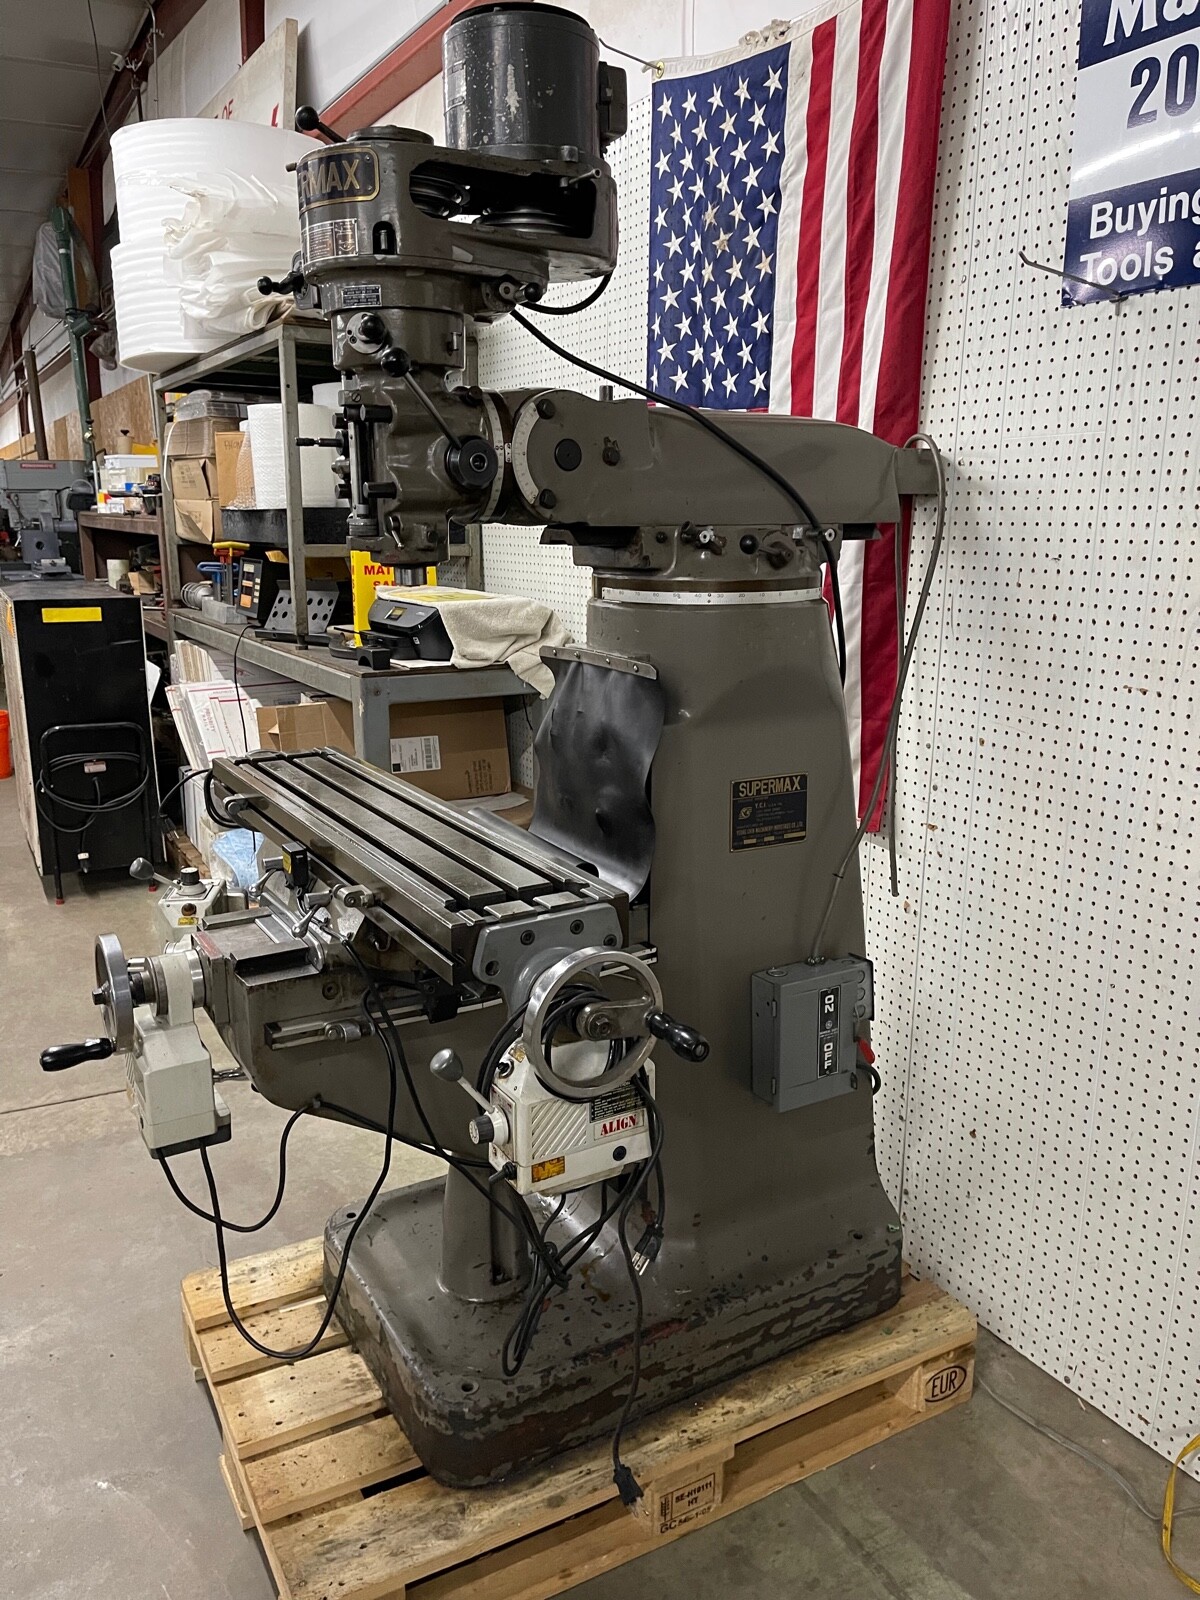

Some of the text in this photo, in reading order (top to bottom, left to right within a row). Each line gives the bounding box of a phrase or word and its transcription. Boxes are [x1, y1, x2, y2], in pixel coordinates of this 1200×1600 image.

[1080, 241, 1174, 286] Tools
[739, 775, 801, 797] SUPERMAX
[824, 994, 835, 1014] ON
[823, 1042, 834, 1070] OFF
[600, 1113, 637, 1136] ALIGN
[931, 1370, 958, 1398] EUR
